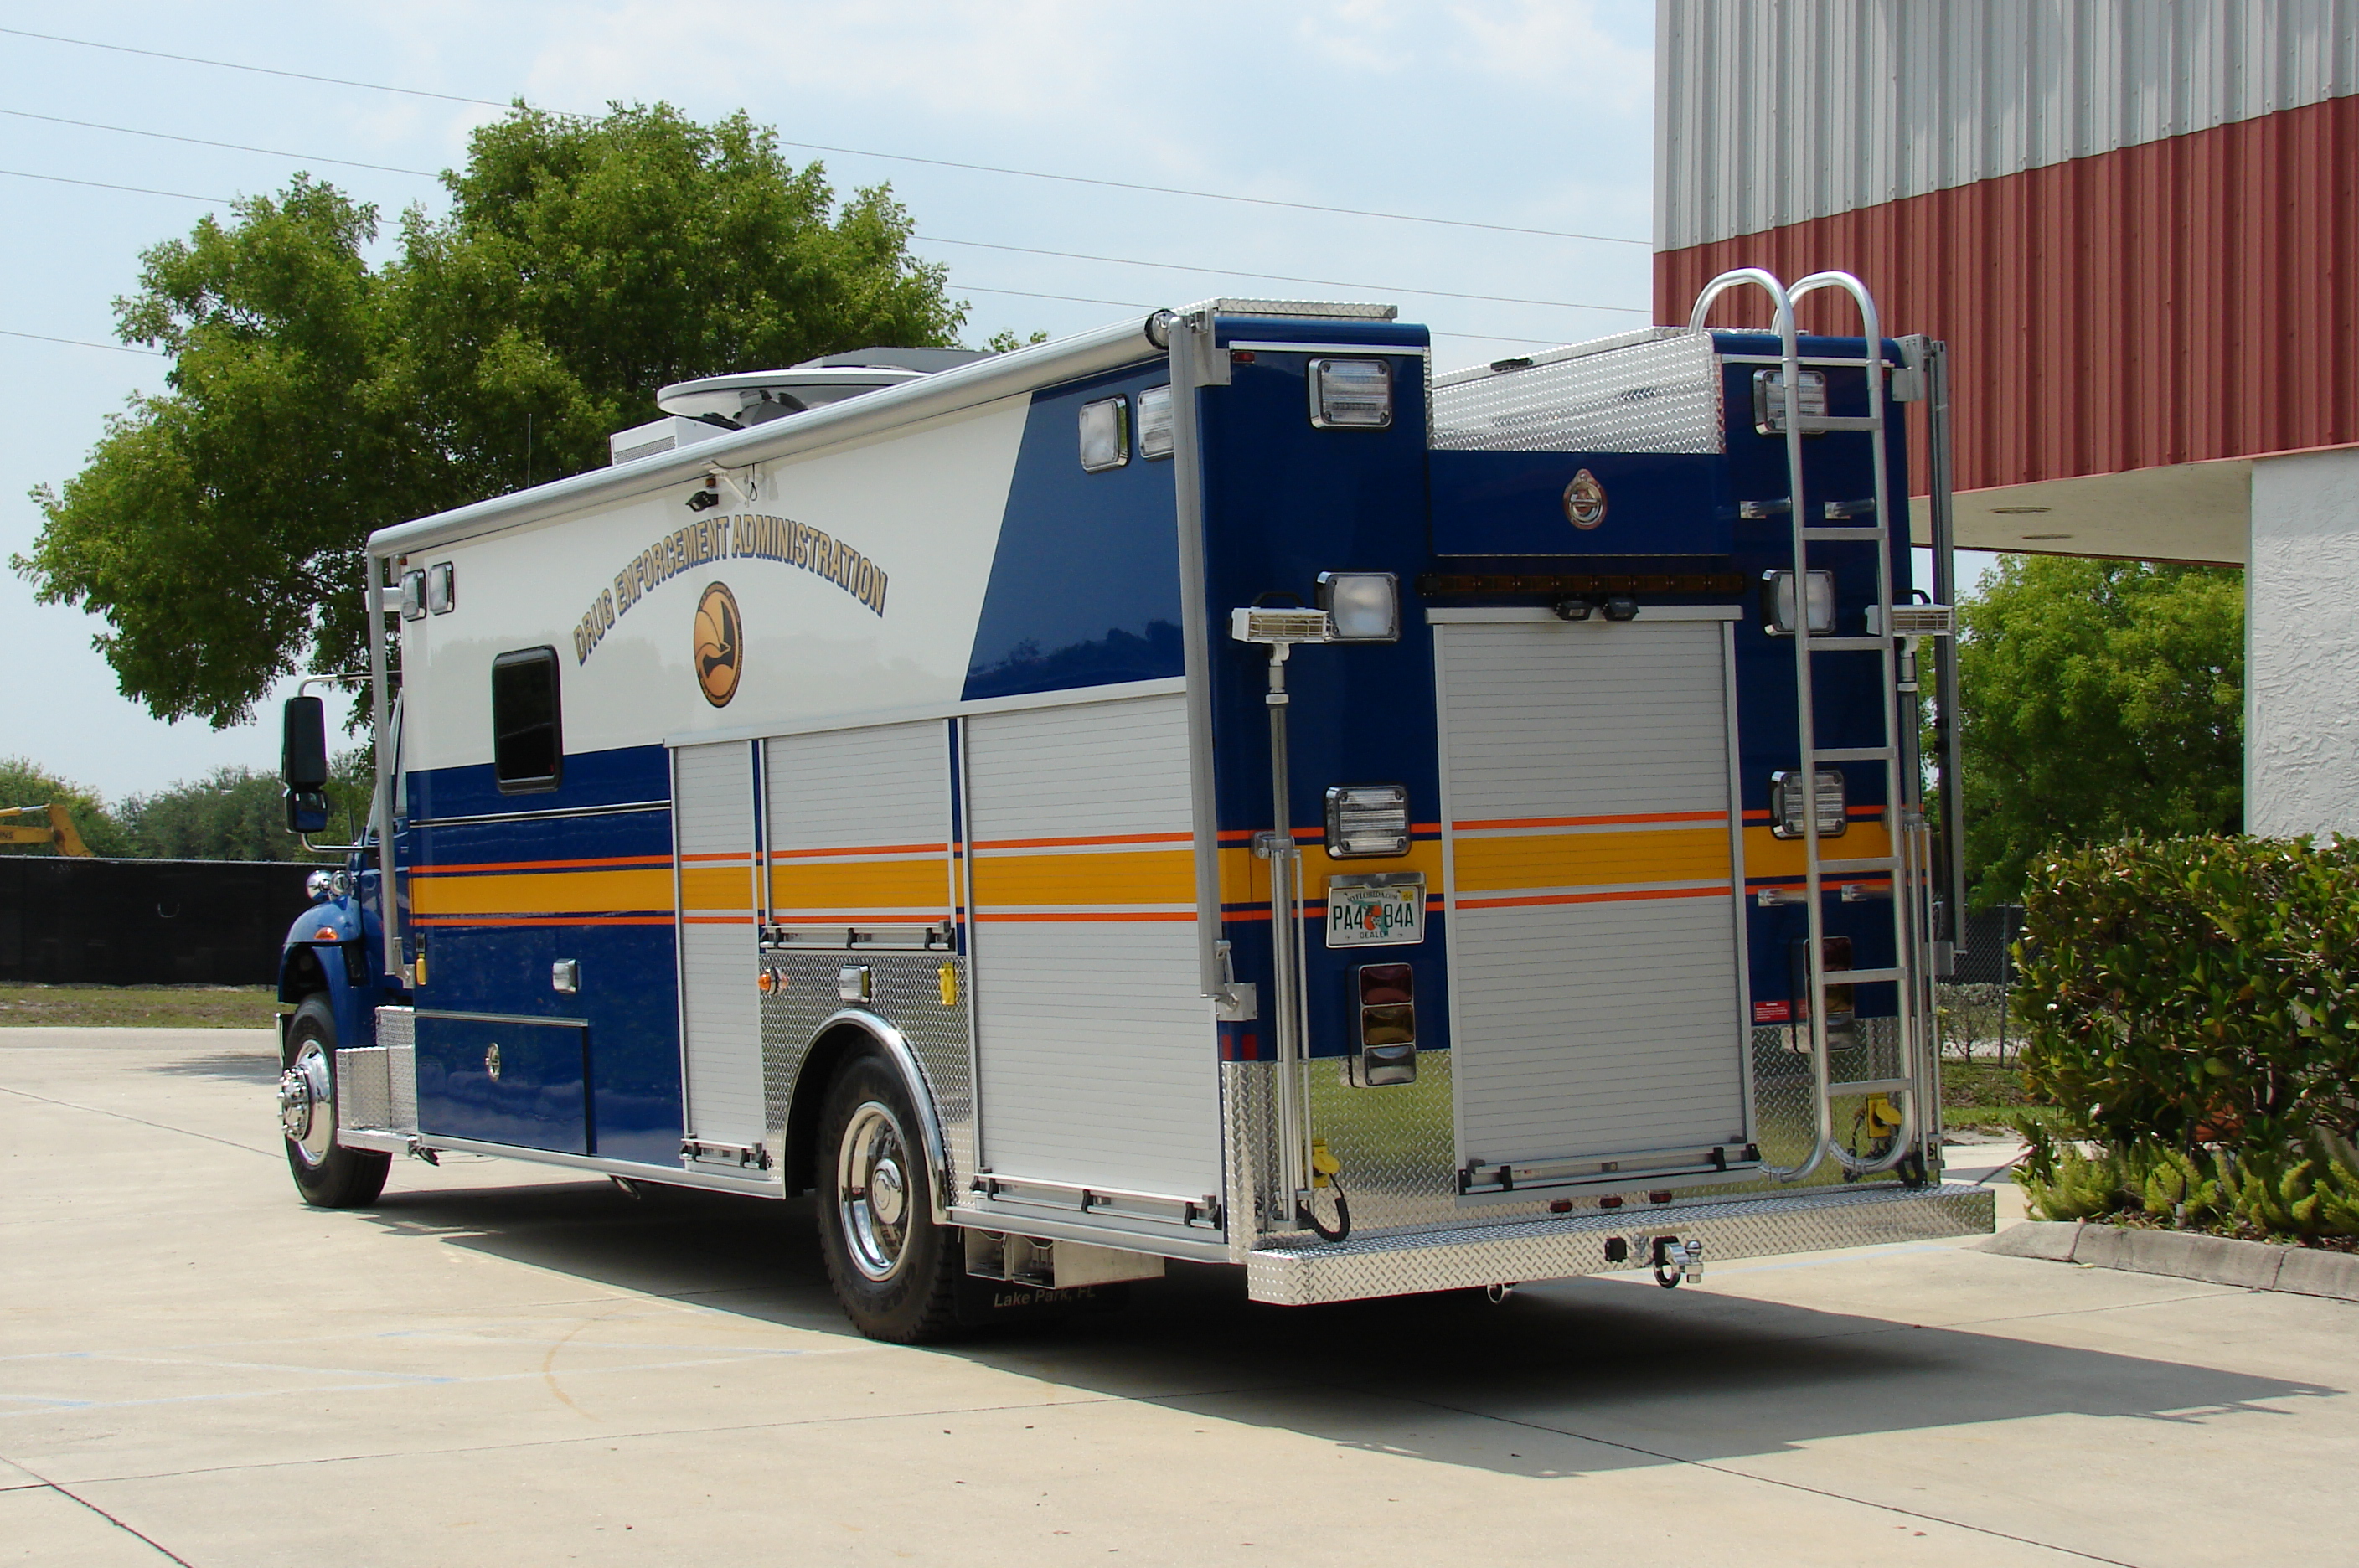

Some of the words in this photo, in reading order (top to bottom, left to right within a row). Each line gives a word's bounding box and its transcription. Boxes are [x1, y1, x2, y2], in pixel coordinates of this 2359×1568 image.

[573, 588, 615, 667] DRUG
[614, 516, 730, 618] ENFORCEMENT
[732, 513, 889, 618] ADMINISTRATION
[1333, 905, 1363, 931] PA4
[1383, 903, 1414, 928] 84A
[1360, 931, 1389, 939] DEALER
[994, 1291, 1031, 1308] Lake
[1078, 1287, 1096, 1298] FL
